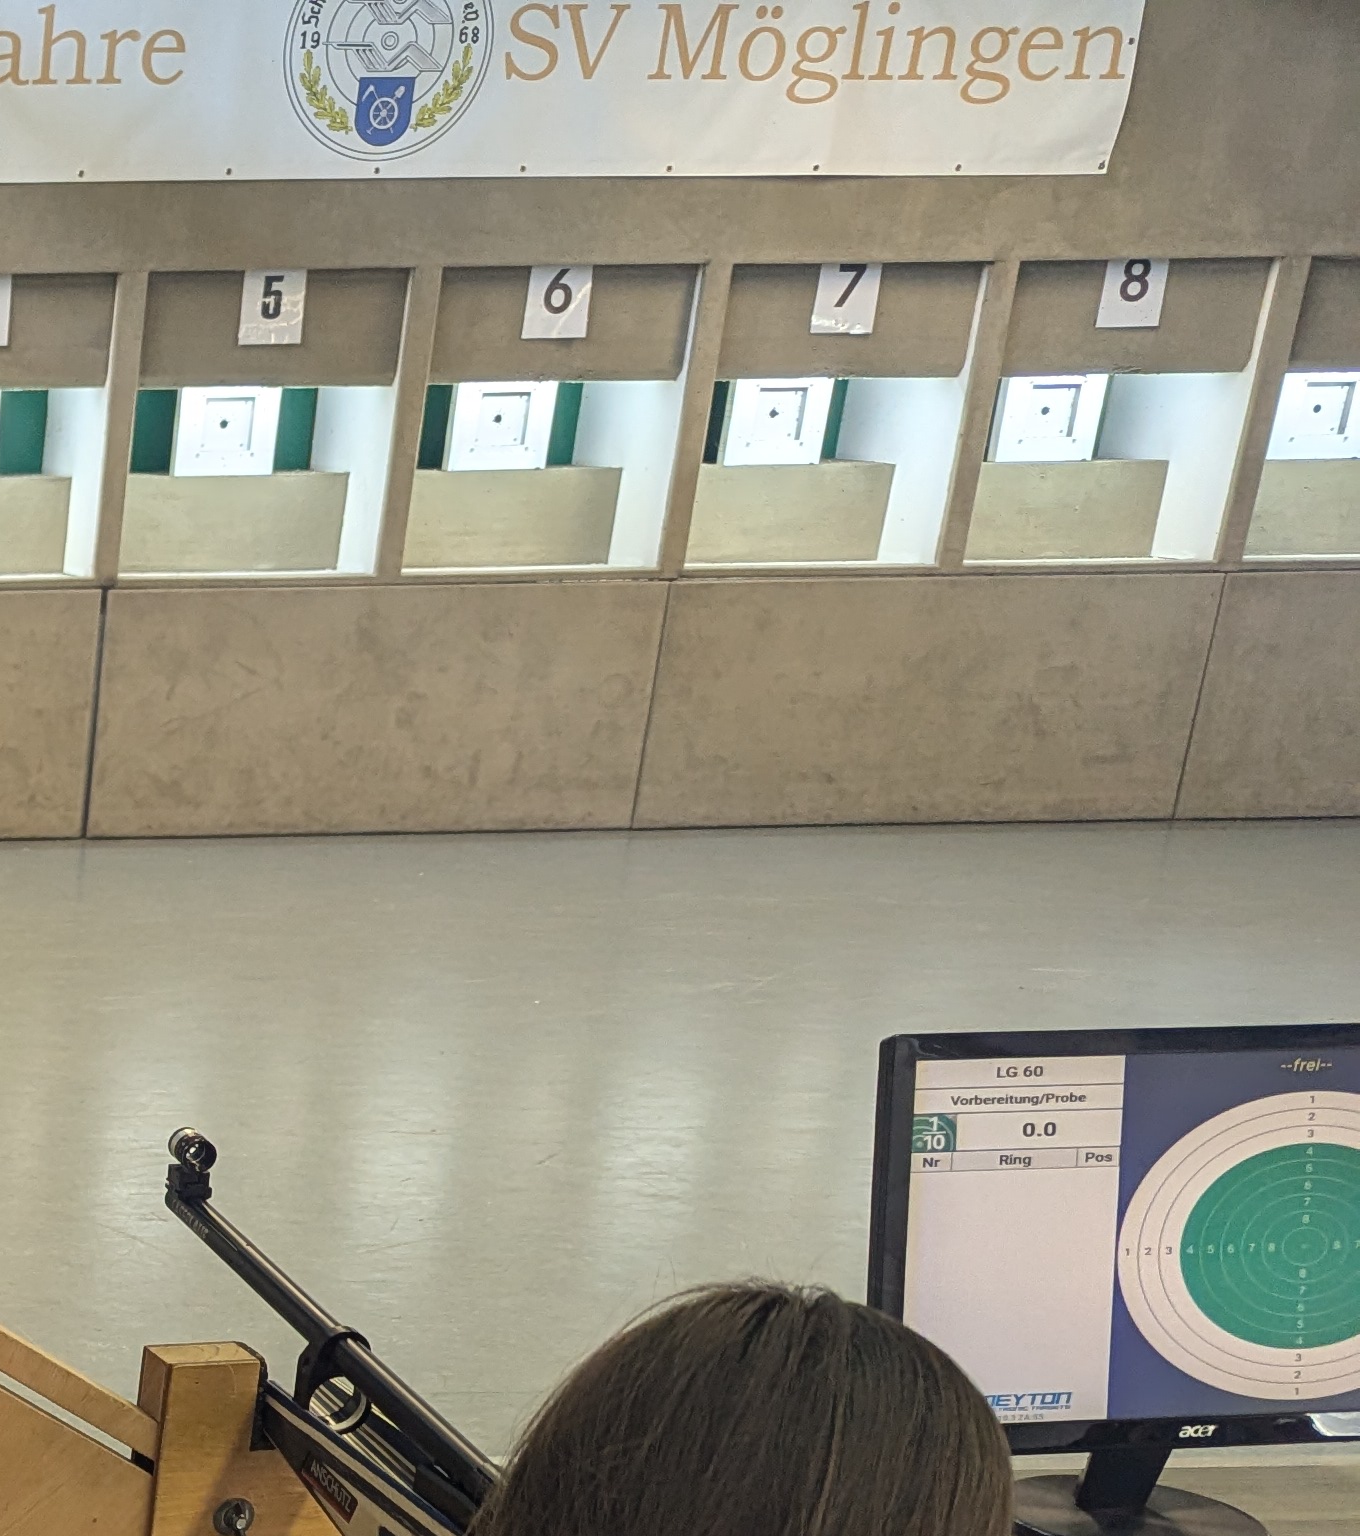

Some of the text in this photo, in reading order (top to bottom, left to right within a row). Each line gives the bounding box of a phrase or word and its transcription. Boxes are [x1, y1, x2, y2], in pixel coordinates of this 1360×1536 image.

[300, 30, 321, 49] 19
[459, 26, 480, 44] 68
[505, 0, 1126, 106] SV Möglingen
[834, 264, 868, 308] 7
[1118, 259, 1152, 303] 8
[261, 275, 285, 320] 5
[543, 269, 572, 314] 6
[996, 1065, 1044, 1079] LG 60
[950, 1093, 1087, 1106] Vorbereitung/Probe
[1310, 1095, 1315, 1104] 1
[928, 1116, 938, 1131] 1
[1307, 1112, 1316, 1122] 2
[1022, 1121, 1057, 1138] 0.0
[1307, 1129, 1315, 1138] 3
[923, 1134, 945, 1151] 10
[922, 1152, 1113, 1168] Nr Ring Pos
[1125, 1248, 1131, 1257] 1
[1144, 1247, 1152, 1256] 2
[1165, 1246, 1173, 1255] 3
[1294, 1353, 1302, 1362] 3
[1293, 1370, 1302, 1380] 2
[1294, 1387, 1300, 1396] 1
[1178, 1423, 1219, 1438] acer
